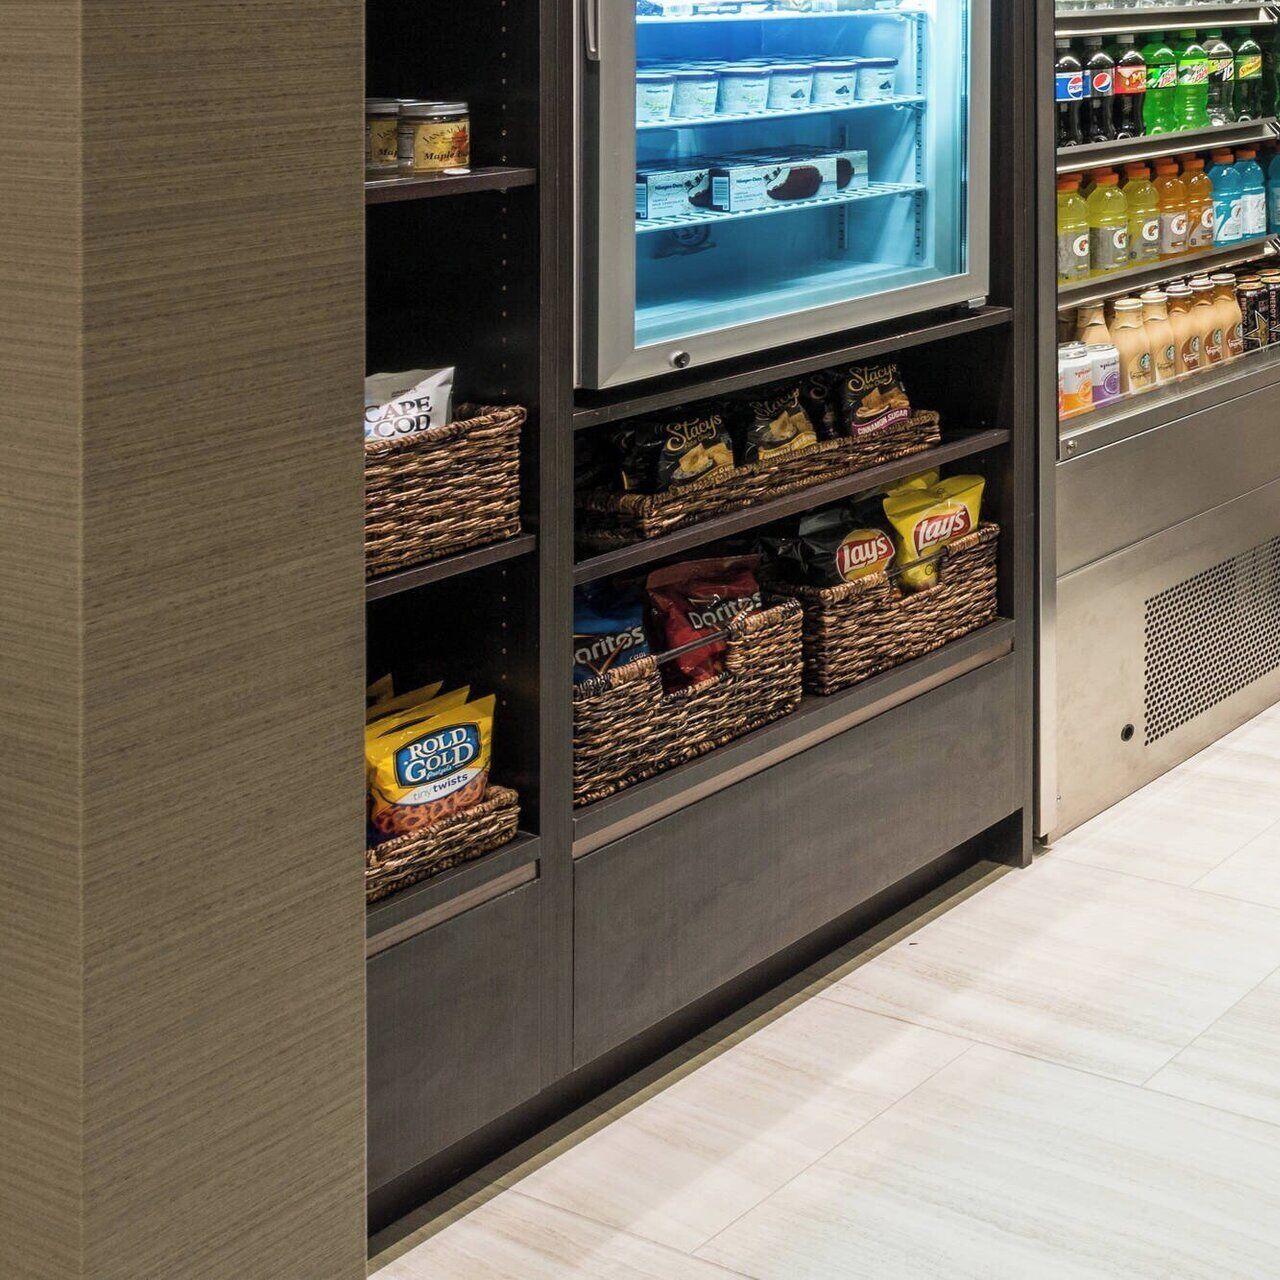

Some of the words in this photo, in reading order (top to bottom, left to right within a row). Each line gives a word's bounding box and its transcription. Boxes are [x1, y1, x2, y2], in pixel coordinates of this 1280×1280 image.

[424, 150, 455, 162] Maple
[365, 396, 433, 423] CAPE
[887, 409, 909, 421] SUGAR
[373, 414, 431, 438] COD
[918, 509, 966, 552] Lay's
[842, 535, 890, 574] Lay's
[688, 591, 763, 631] Doritos
[407, 727, 468, 761] ROLD
[404, 743, 475, 783] GOLD
[413, 787, 433, 801] tiny
[432, 772, 469, 793] twists
